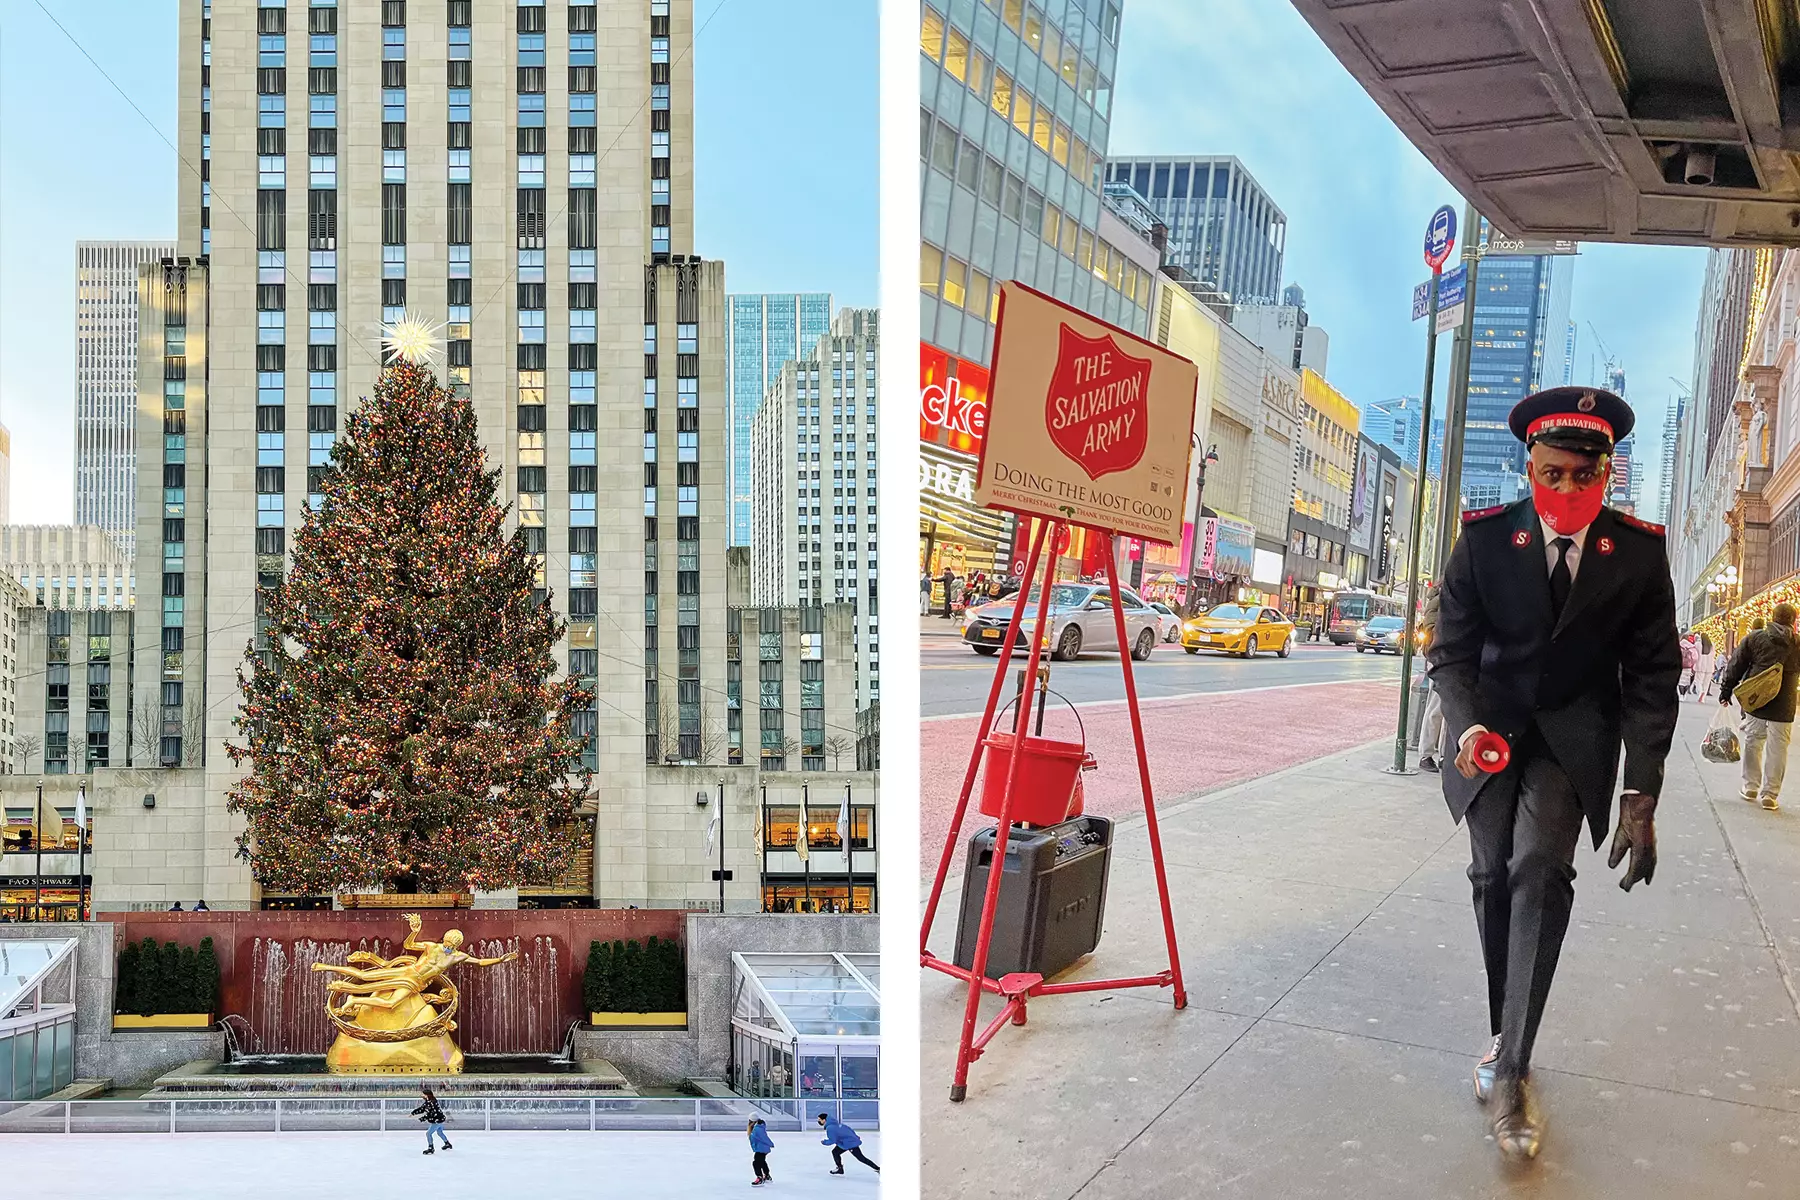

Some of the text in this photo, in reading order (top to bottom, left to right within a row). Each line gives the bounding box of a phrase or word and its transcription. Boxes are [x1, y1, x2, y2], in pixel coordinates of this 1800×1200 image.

[1073, 352, 1112, 385] THE
[1052, 370, 1142, 430] SALVATION
[1081, 408, 1136, 457] ARMY
[1541, 418, 1555, 429] THE
[1556, 418, 1602, 431] SALVATION
[992, 489, 1016, 501] MERRY
[994, 462, 1173, 522] DOING THE MOST GOOD
[1076, 508, 1097, 519] THANK
[1098, 514, 1111, 523] YOU
[1112, 516, 1124, 525] FOR
[1124, 519, 1140, 528] YOUR
[1205, 520, 1214, 535] 30
[1383, 515, 1391, 541] KAY
[1516, 533, 1526, 545] S
[1600, 539, 1610, 551] S
[1203, 541, 1213, 557] 50
